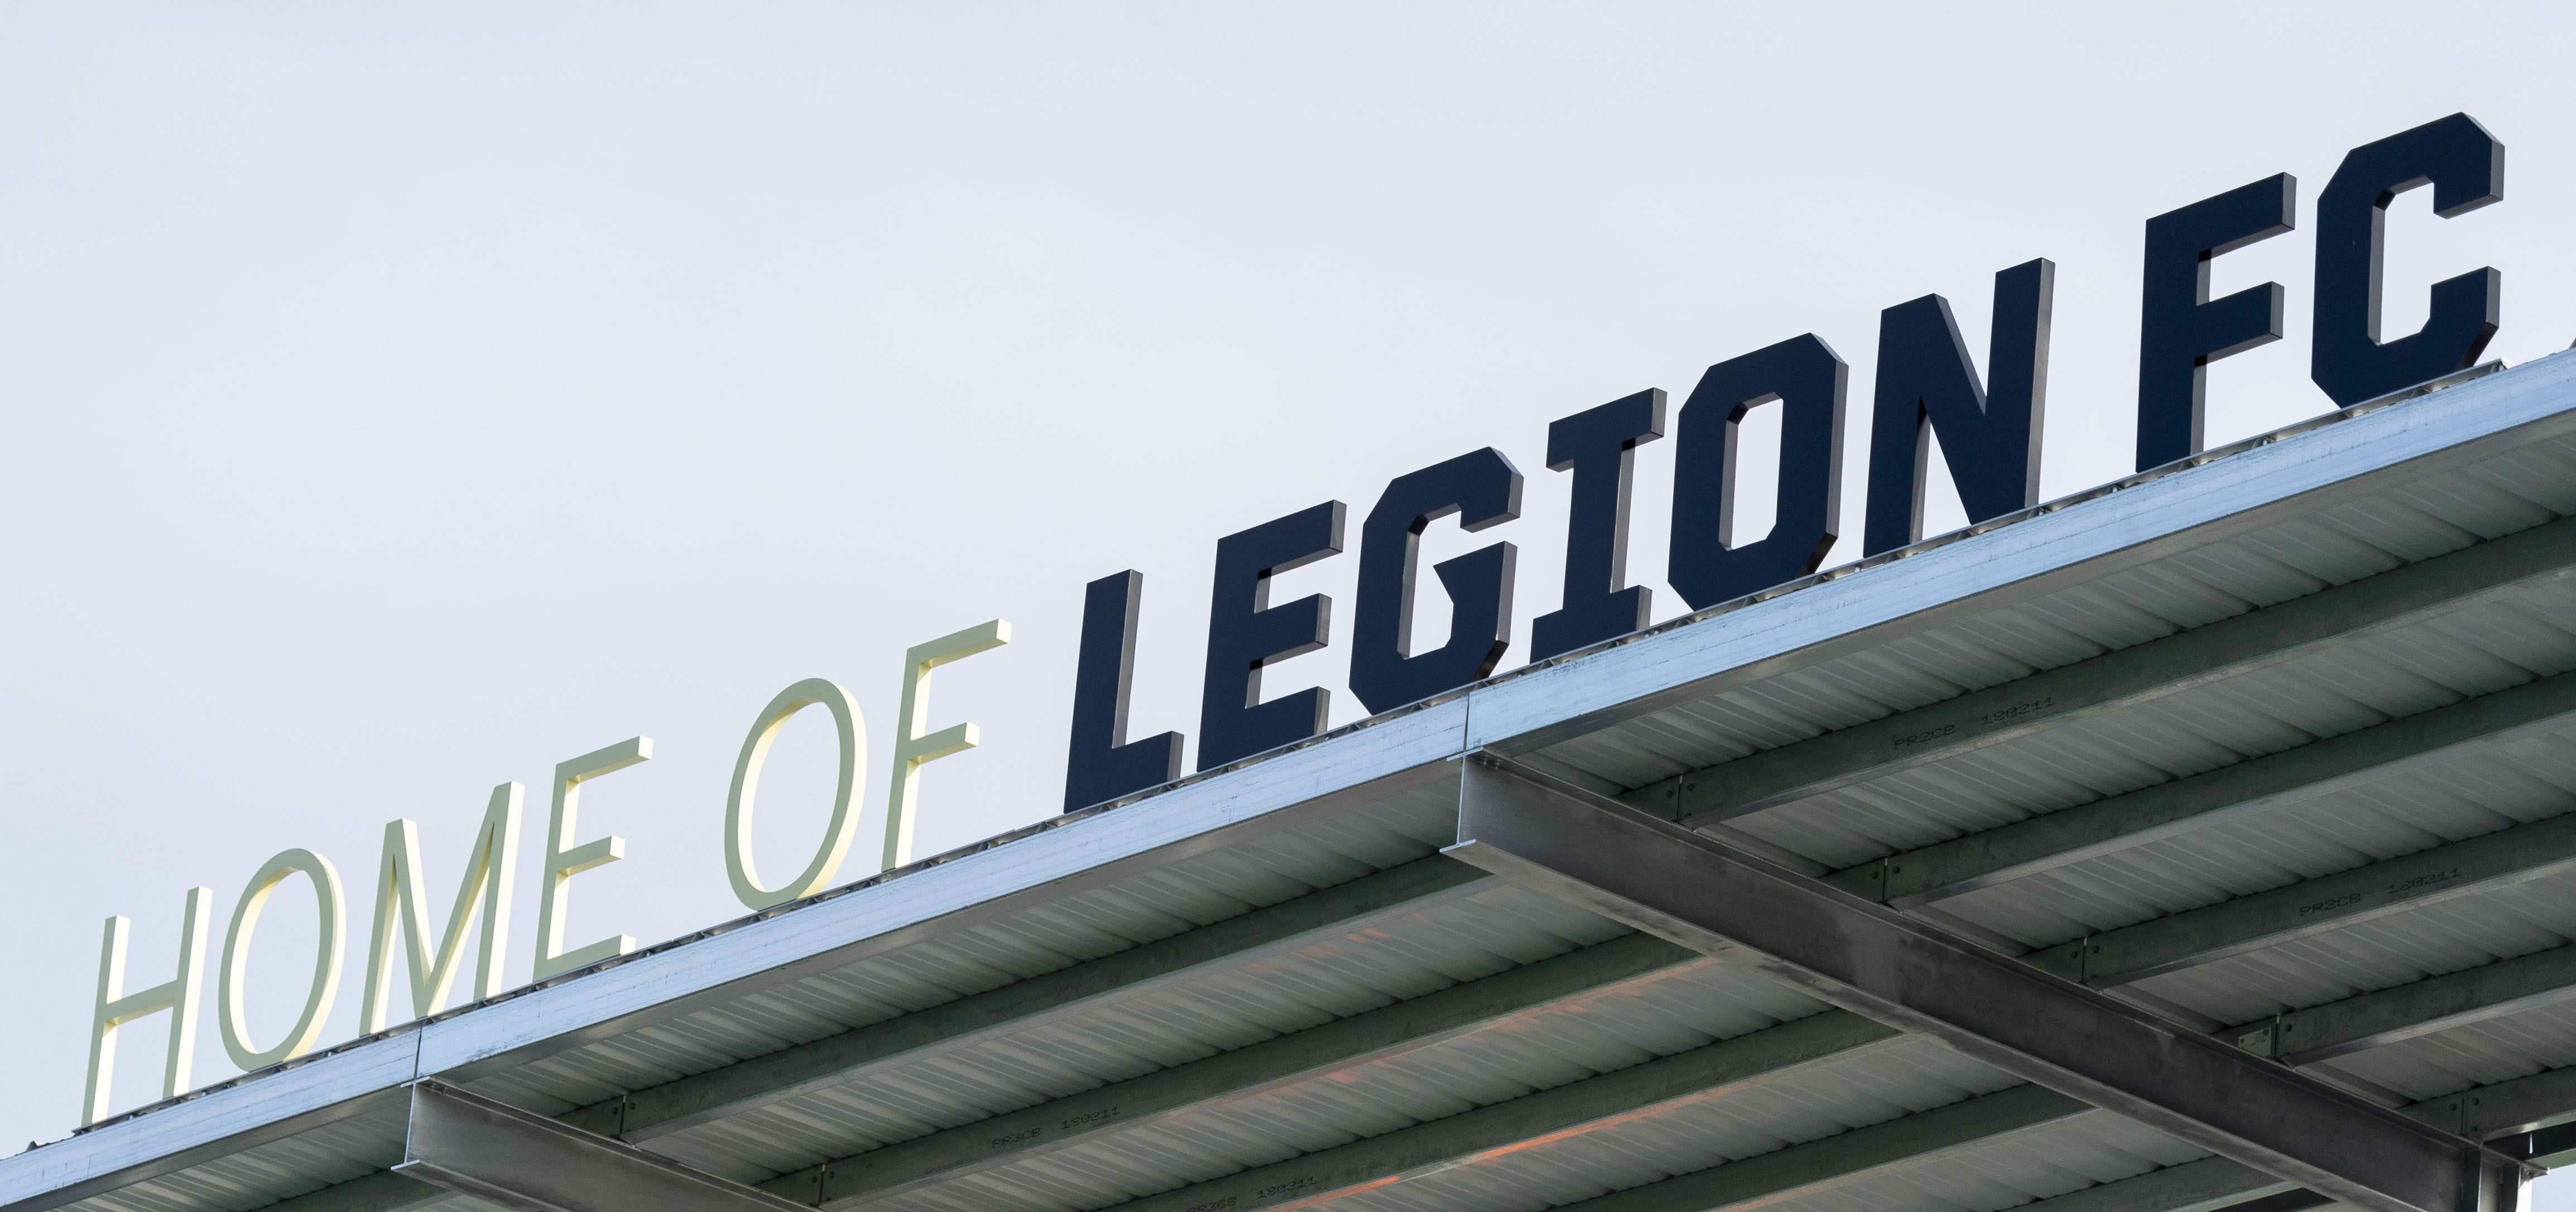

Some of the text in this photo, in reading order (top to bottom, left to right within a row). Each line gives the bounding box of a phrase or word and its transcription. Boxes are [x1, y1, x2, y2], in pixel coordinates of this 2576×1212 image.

[81, 112, 2505, 1127] HOME OF LEGION FC
